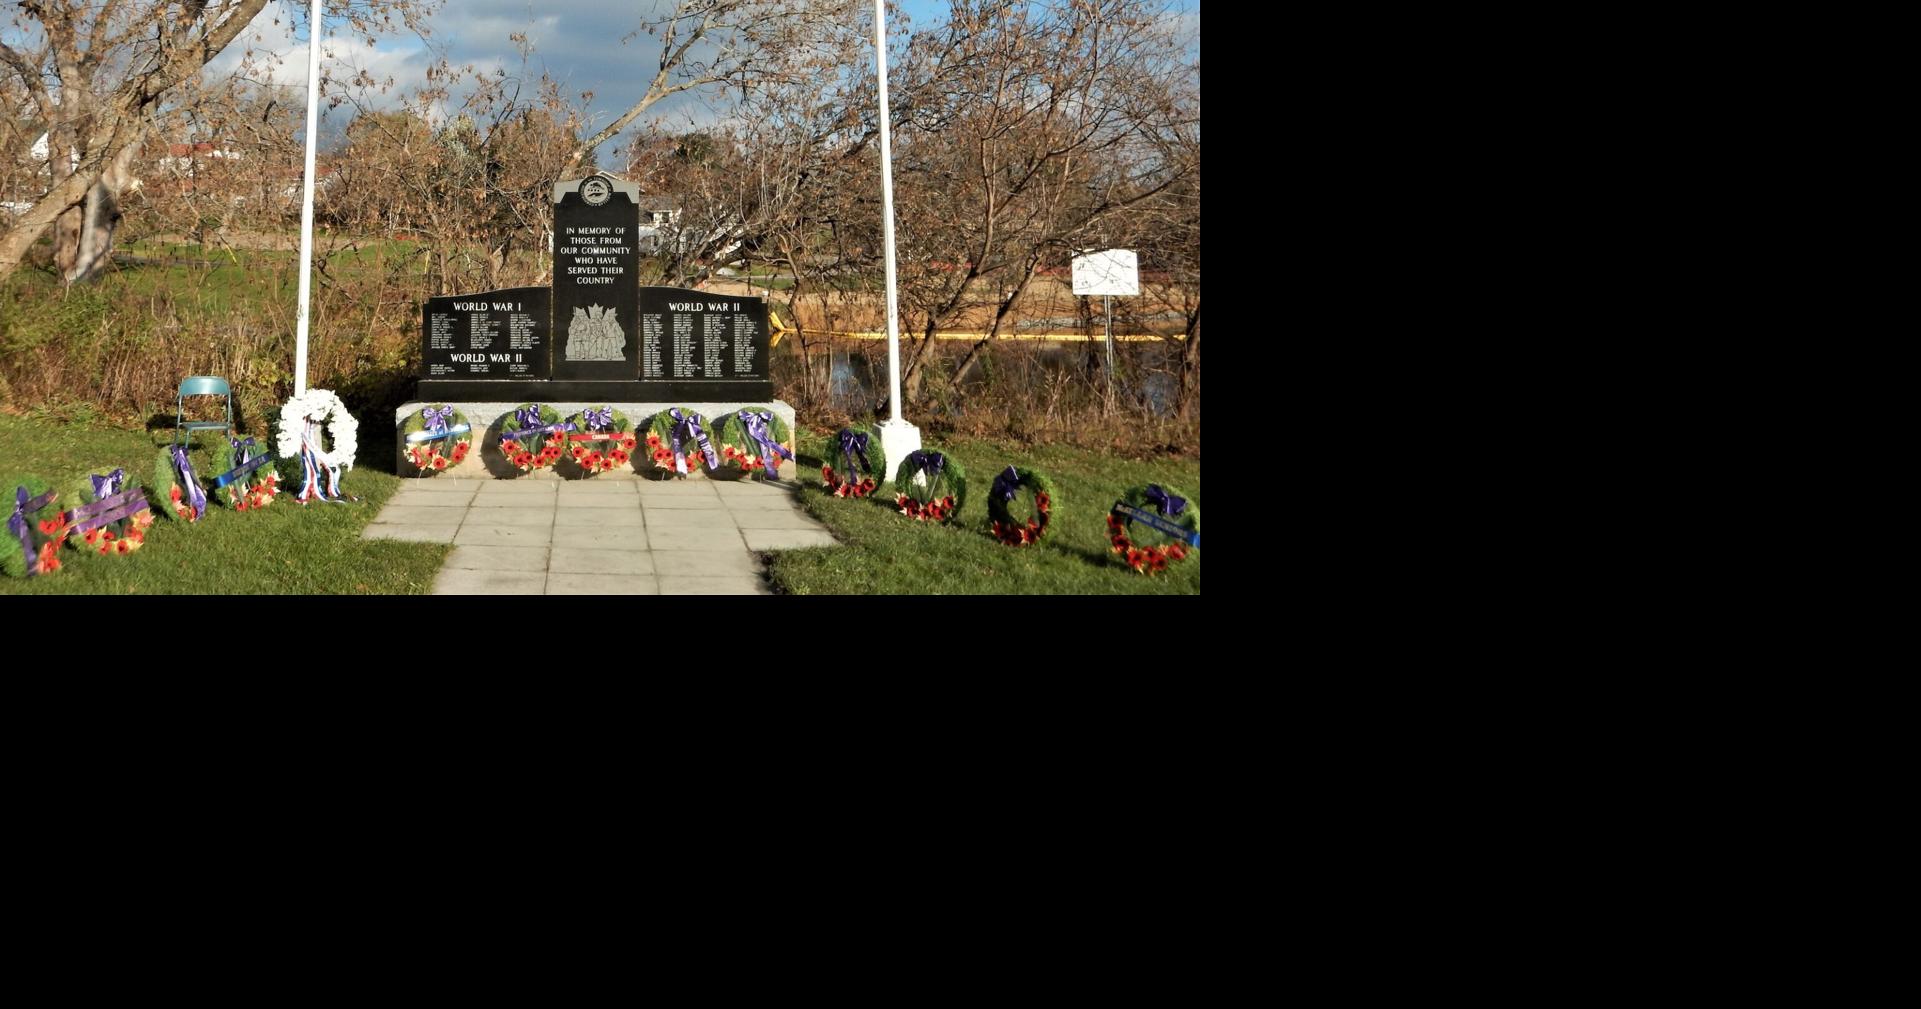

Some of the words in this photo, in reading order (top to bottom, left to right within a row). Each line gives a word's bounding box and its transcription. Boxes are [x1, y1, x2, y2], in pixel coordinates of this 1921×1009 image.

[566, 227, 575, 235] IN
[578, 227, 611, 235] MEMORY
[615, 227, 627, 235] OF
[570, 237, 597, 245] THOSE
[600, 237, 622, 245] FROM
[560, 247, 578, 255] OUR
[581, 247, 631, 255] COMMUNITY
[574, 257, 594, 265] WHO
[596, 257, 618, 265] HAVE
[567, 267, 598, 275] SERVED
[601, 267, 624, 275] THEIR
[576, 277, 615, 285] COUNTRY
[453, 302, 488, 311] WORLD
[492, 302, 513, 311] WAR
[668, 302, 704, 312] WORLD
[708, 302, 729, 312] WAR
[733, 302, 740, 312] II
[450, 353, 486, 363] WORLD
[490, 353, 511, 363] WAR
[515, 353, 522, 363] II
